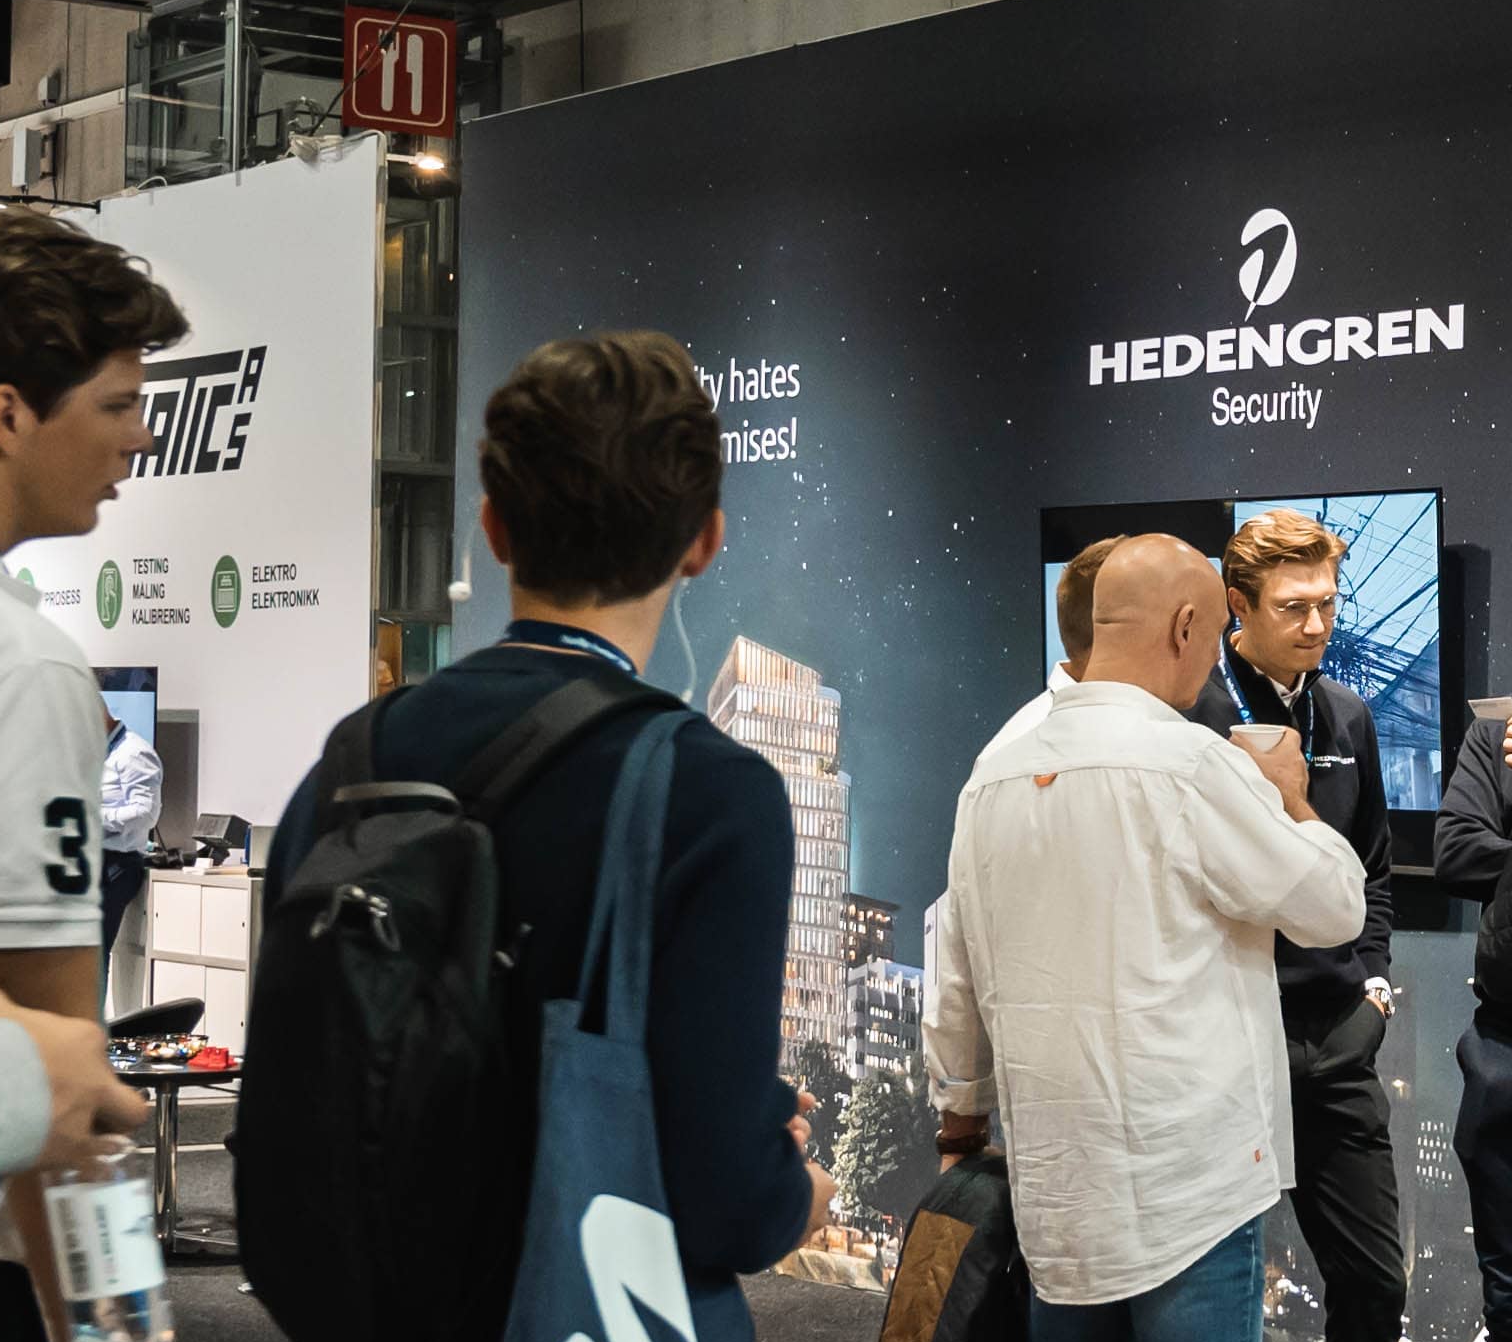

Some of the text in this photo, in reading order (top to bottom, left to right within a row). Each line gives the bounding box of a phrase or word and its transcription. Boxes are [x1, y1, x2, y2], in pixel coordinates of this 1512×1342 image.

[1088, 304, 1464, 385] HEDENGREN
[730, 358, 800, 402] hates
[1211, 382, 1323, 430] Security
[720, 417, 797, 463] mises!
[133, 557, 169, 574] TESTING
[252, 564, 297, 583] ELEKTRO
[44, 589, 81, 607] PROSESS
[251, 588, 319, 609] ELEKTRONIKK
[132, 607, 190, 625] KALIBRERING
[45, 797, 92, 895] 3
